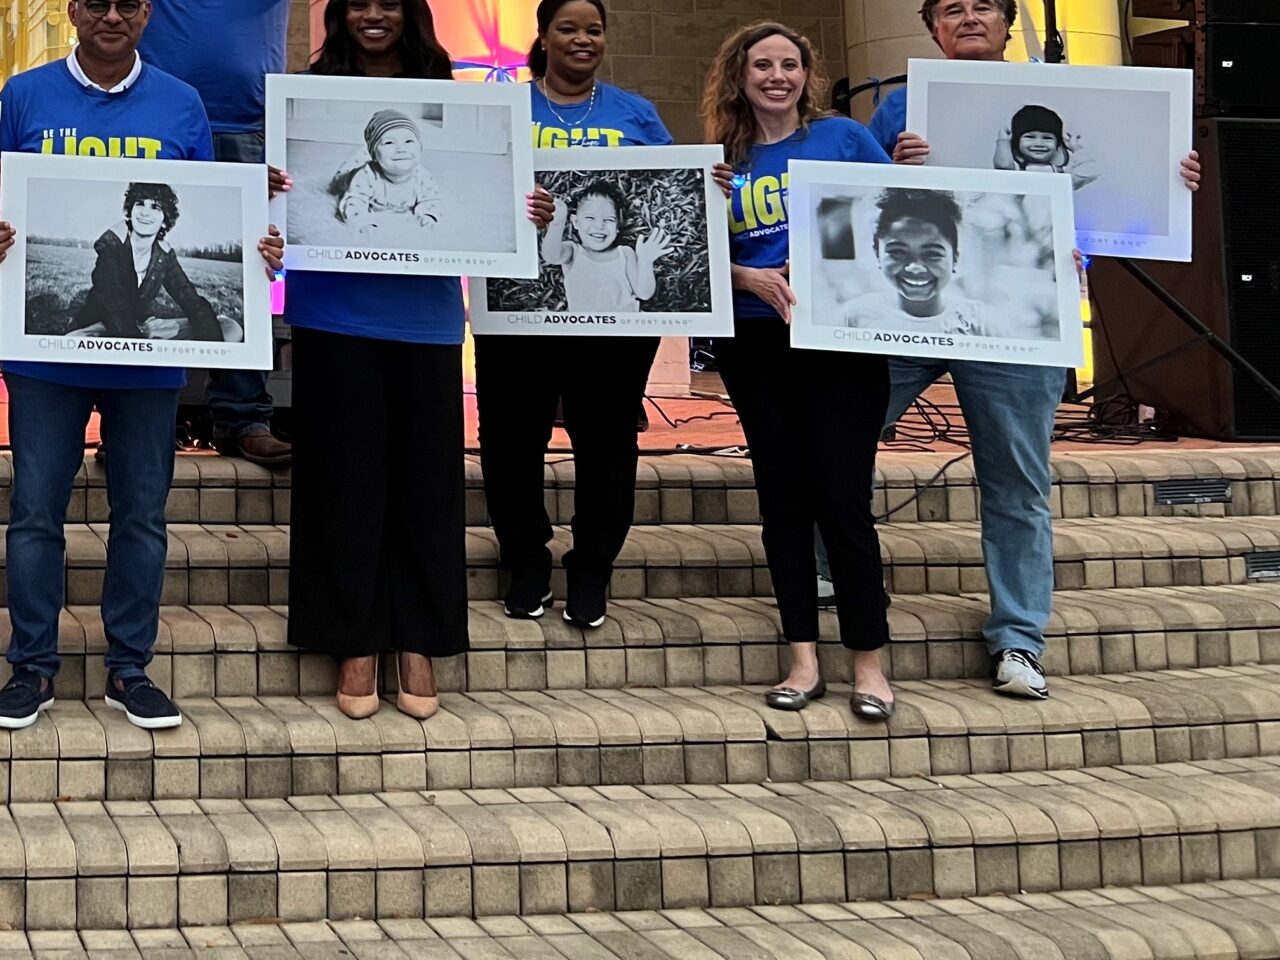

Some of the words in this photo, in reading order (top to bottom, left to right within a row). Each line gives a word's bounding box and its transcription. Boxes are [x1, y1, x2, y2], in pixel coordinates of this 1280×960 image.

[43, 129, 54, 139] BE
[59, 127, 77, 137] THE
[749, 223, 789, 238] ADVOCATE
[345, 250, 420, 262] ADVOCATES
[544, 315, 616, 324] ADVOCATES
[874, 332, 954, 347] ADVOCATES
[77, 340, 153, 352] ADVOCATES
